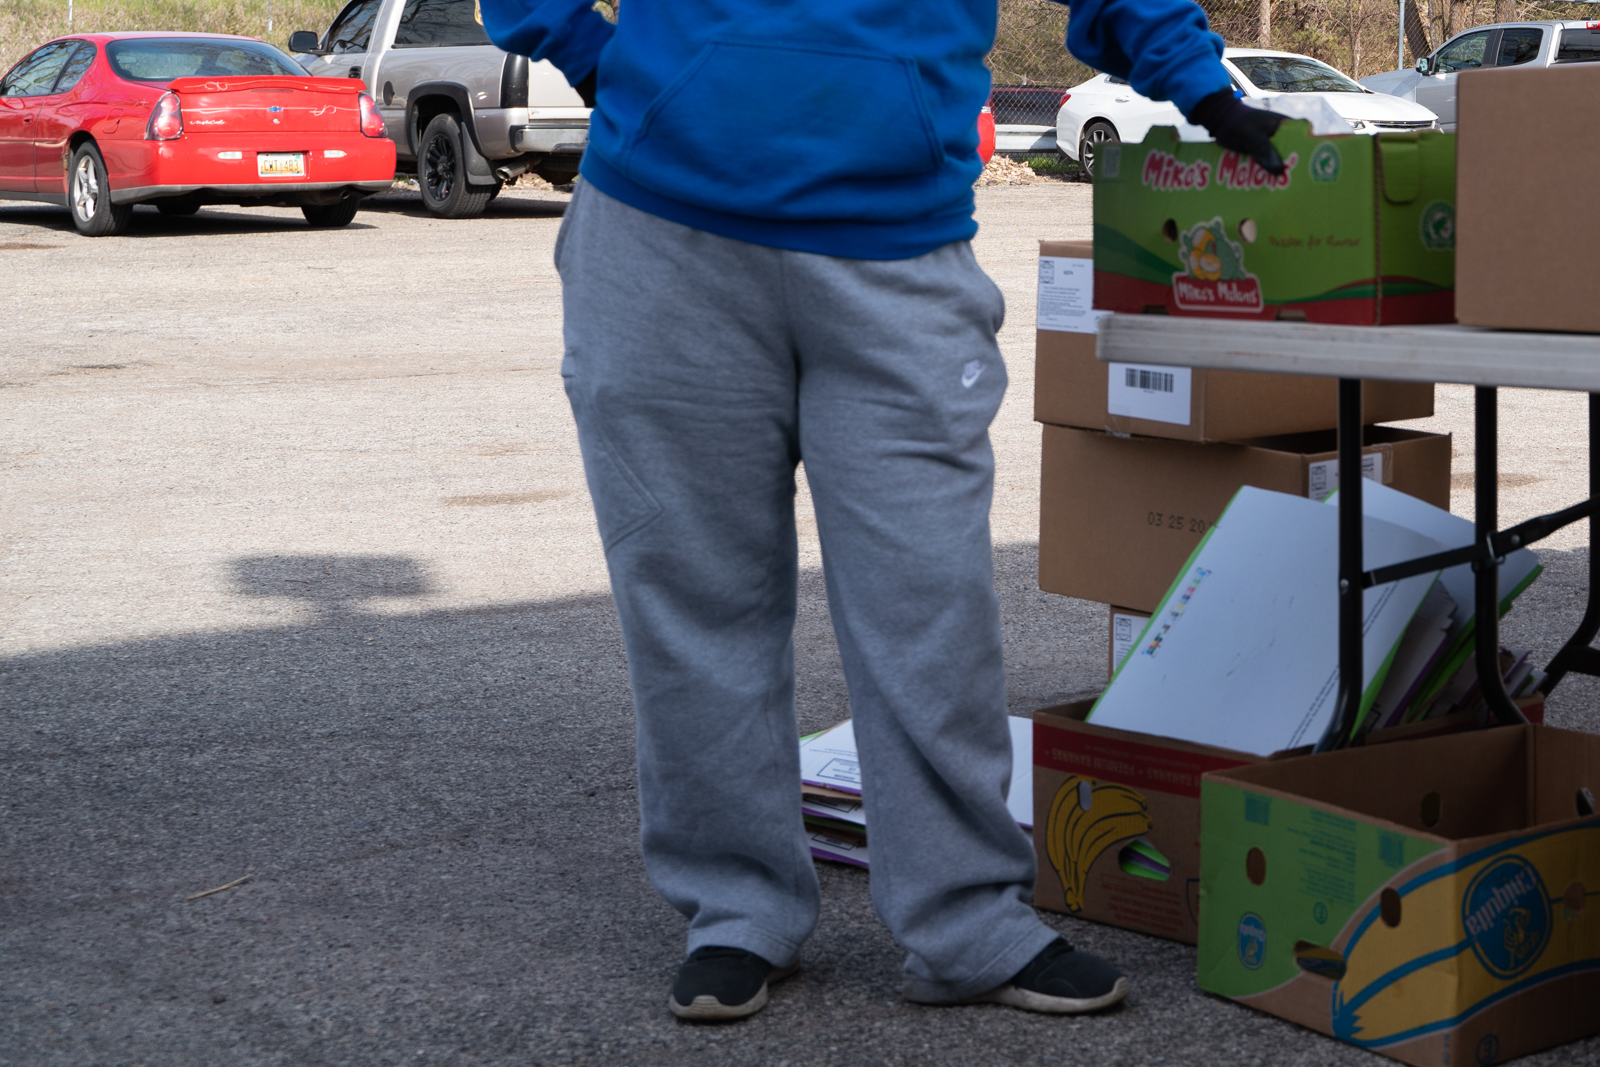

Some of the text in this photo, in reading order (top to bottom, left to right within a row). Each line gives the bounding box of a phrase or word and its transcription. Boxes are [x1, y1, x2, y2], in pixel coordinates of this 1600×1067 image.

[1143, 150, 1210, 189] Mike's
[1147, 511, 1206, 534] 03 25 20
[1464, 865, 1538, 938] Chiquita
